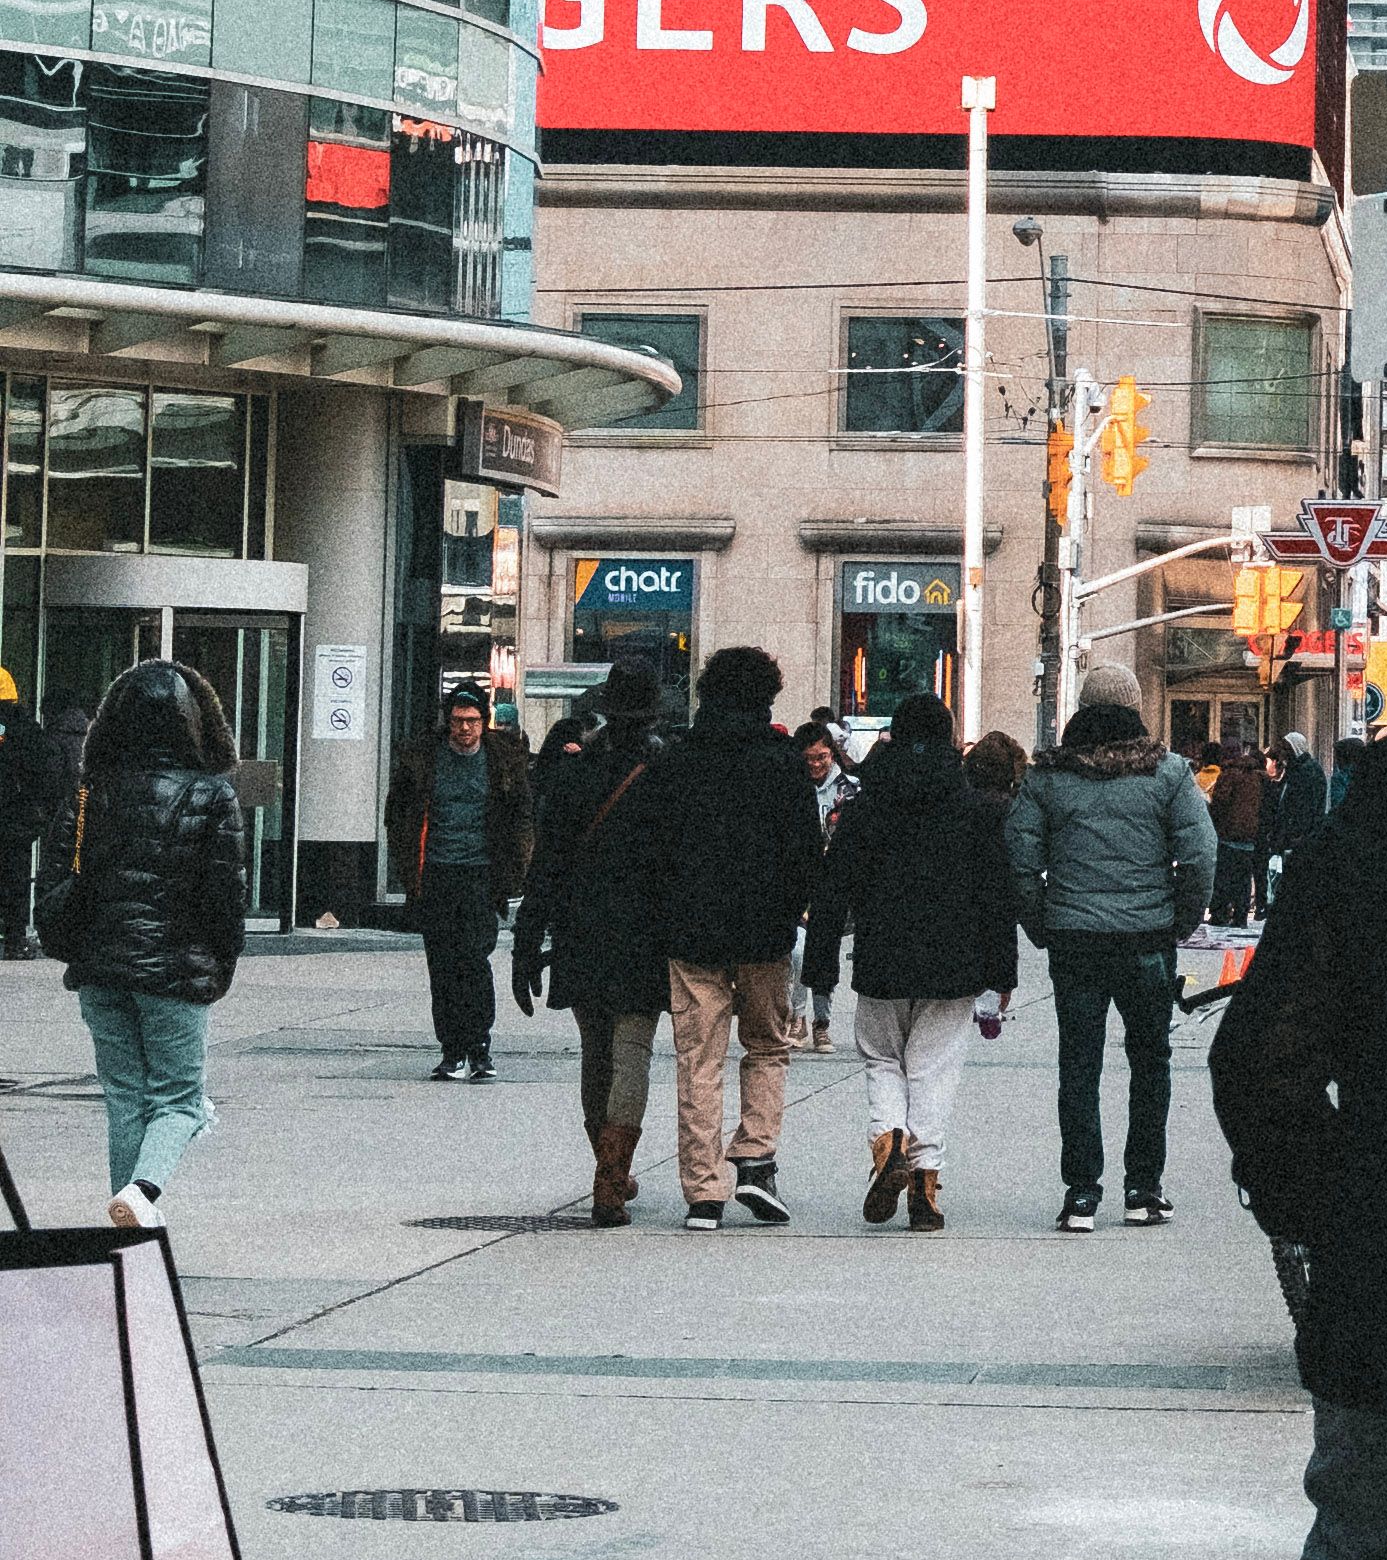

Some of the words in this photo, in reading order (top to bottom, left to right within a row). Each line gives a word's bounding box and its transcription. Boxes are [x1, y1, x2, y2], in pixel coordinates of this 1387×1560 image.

[503, 425, 534, 464] Dundas
[605, 566, 682, 592] chatr
[853, 570, 920, 606] fido
[607, 592, 637, 604] MOBILE
